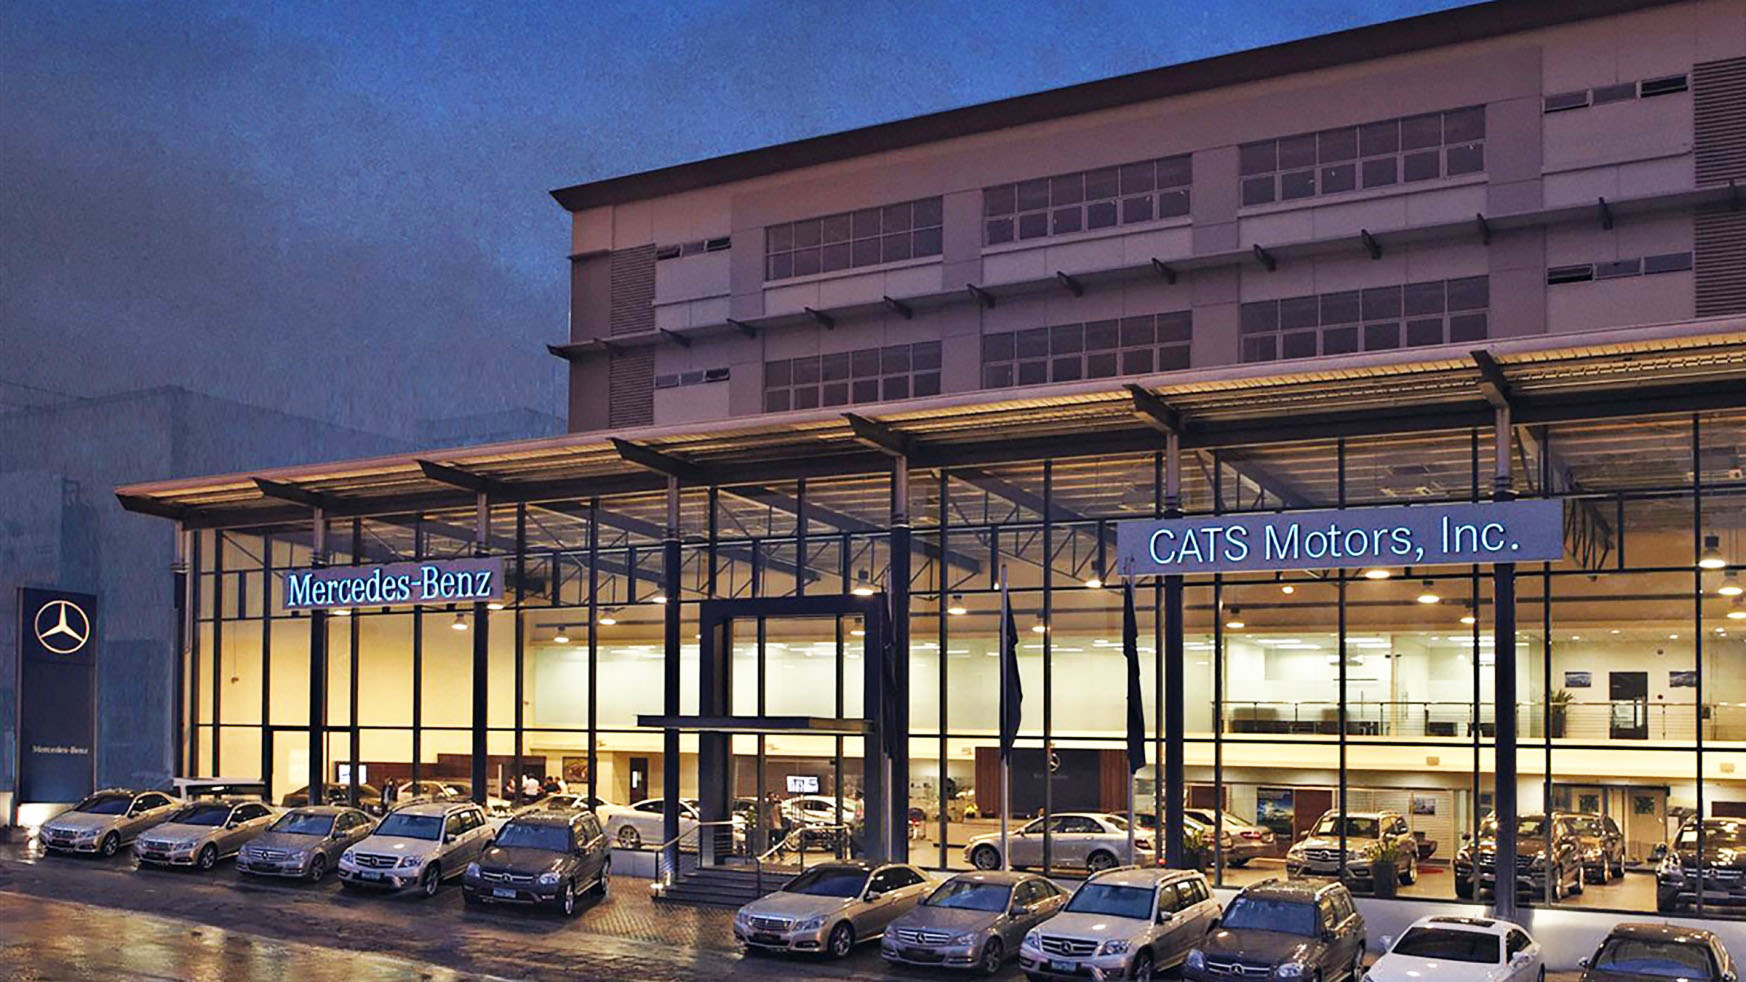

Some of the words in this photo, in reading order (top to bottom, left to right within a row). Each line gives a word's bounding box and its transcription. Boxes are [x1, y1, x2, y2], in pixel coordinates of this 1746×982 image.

[1149, 524, 1249, 565] CATS
[1265, 523, 1425, 562] Motors,
[1441, 515, 1521, 554] Inc.
[287, 565, 492, 606] Mercedes-Benz
